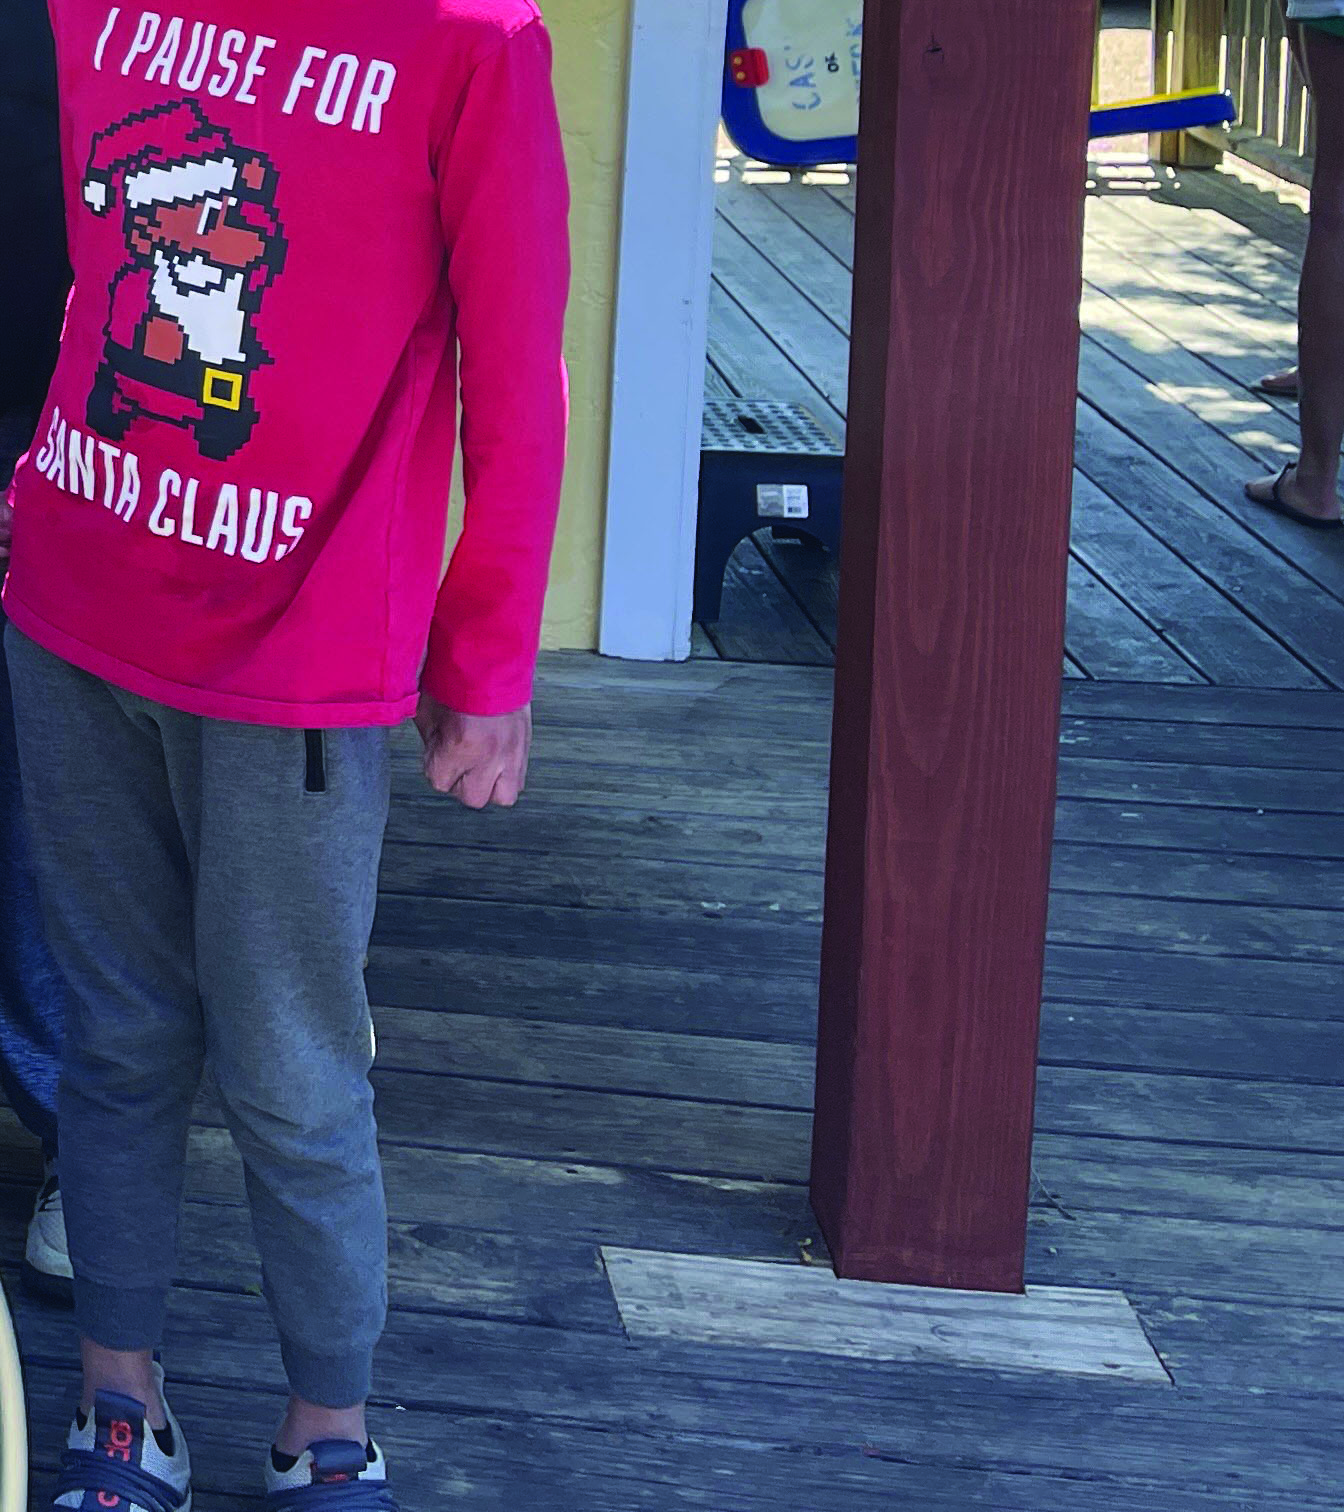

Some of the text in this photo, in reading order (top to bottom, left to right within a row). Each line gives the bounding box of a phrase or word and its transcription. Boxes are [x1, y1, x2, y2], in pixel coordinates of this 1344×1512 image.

[93, 6, 397, 135] I PAUSE FOR
[34, 405, 313, 564] SANTA CLAUS
